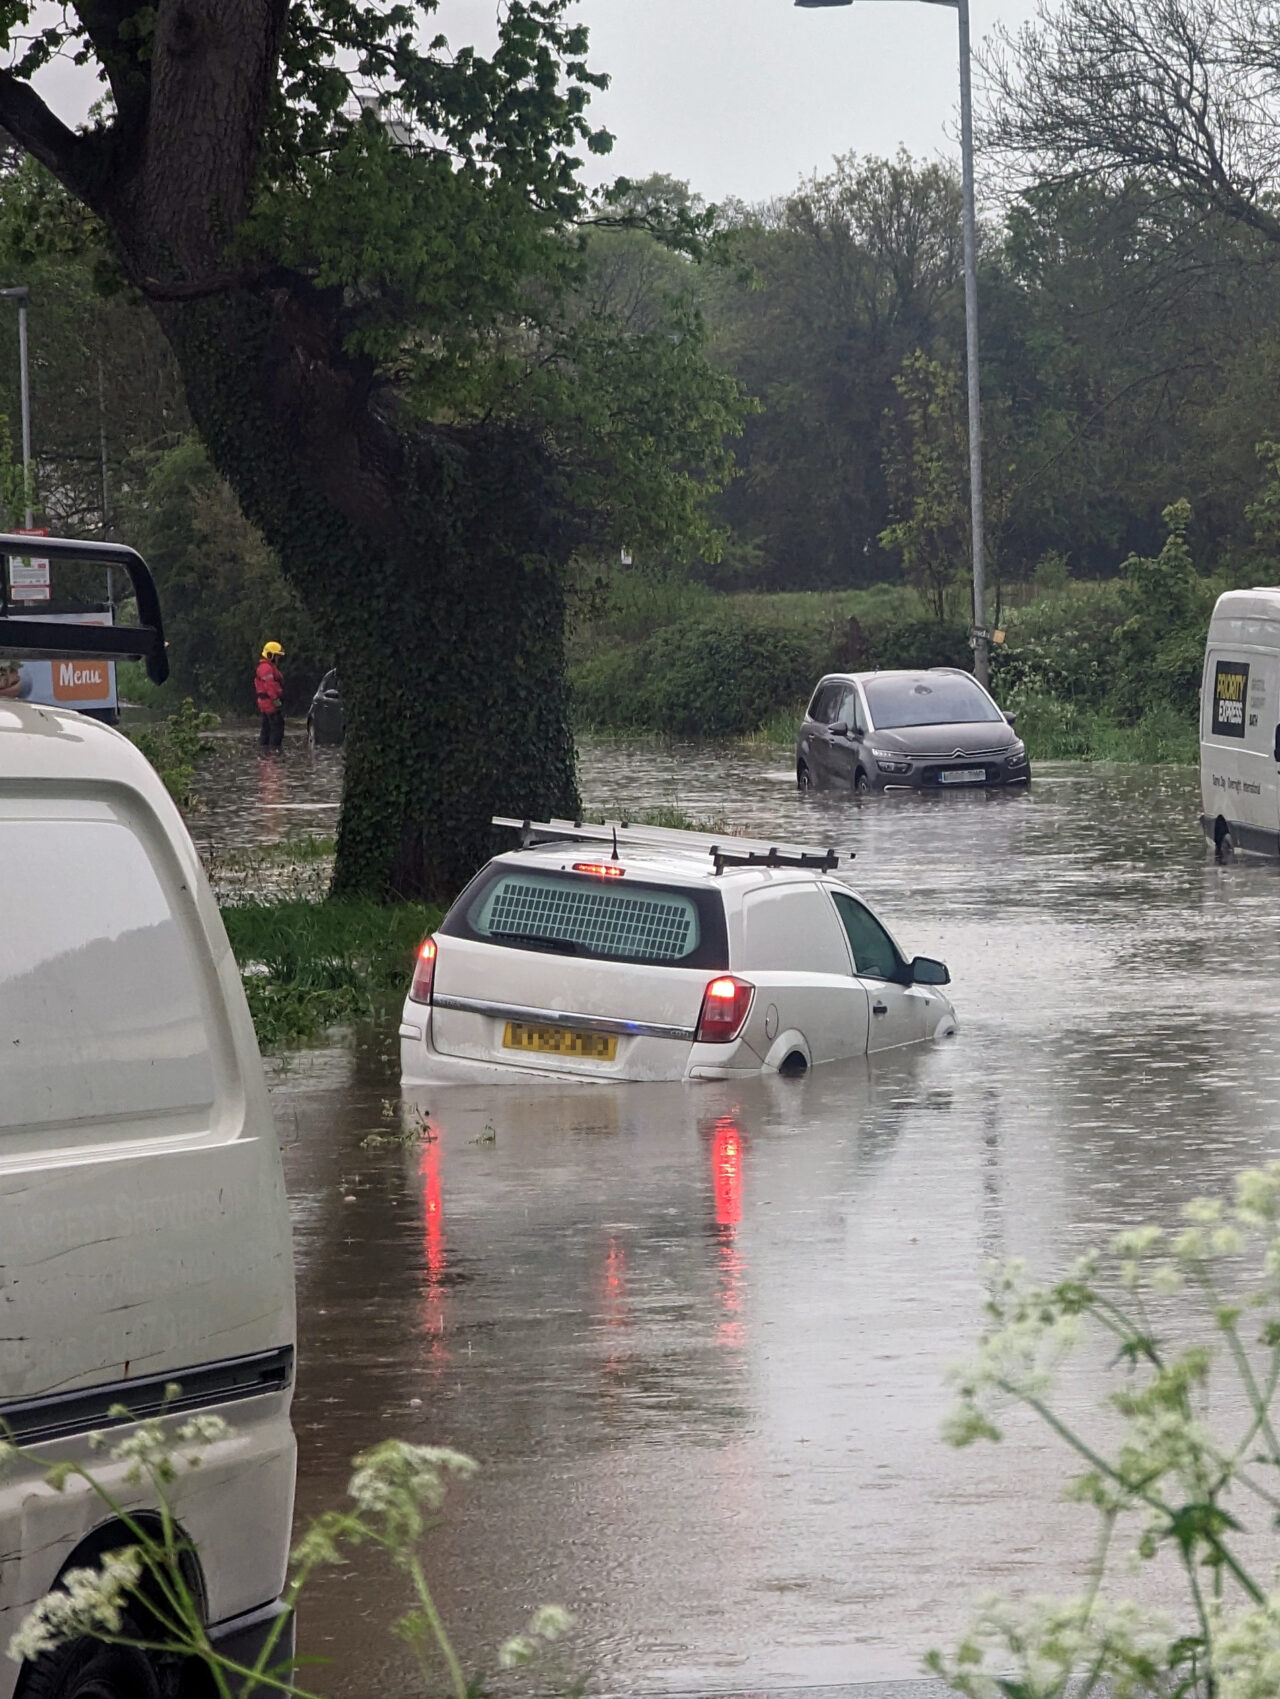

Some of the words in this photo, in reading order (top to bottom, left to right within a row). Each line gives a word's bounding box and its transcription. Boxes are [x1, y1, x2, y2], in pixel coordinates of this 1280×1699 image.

[59, 662, 101, 686] Menu
[1216, 673, 1247, 700] PRIORITY
[1218, 699, 1243, 725] EXPRESS
